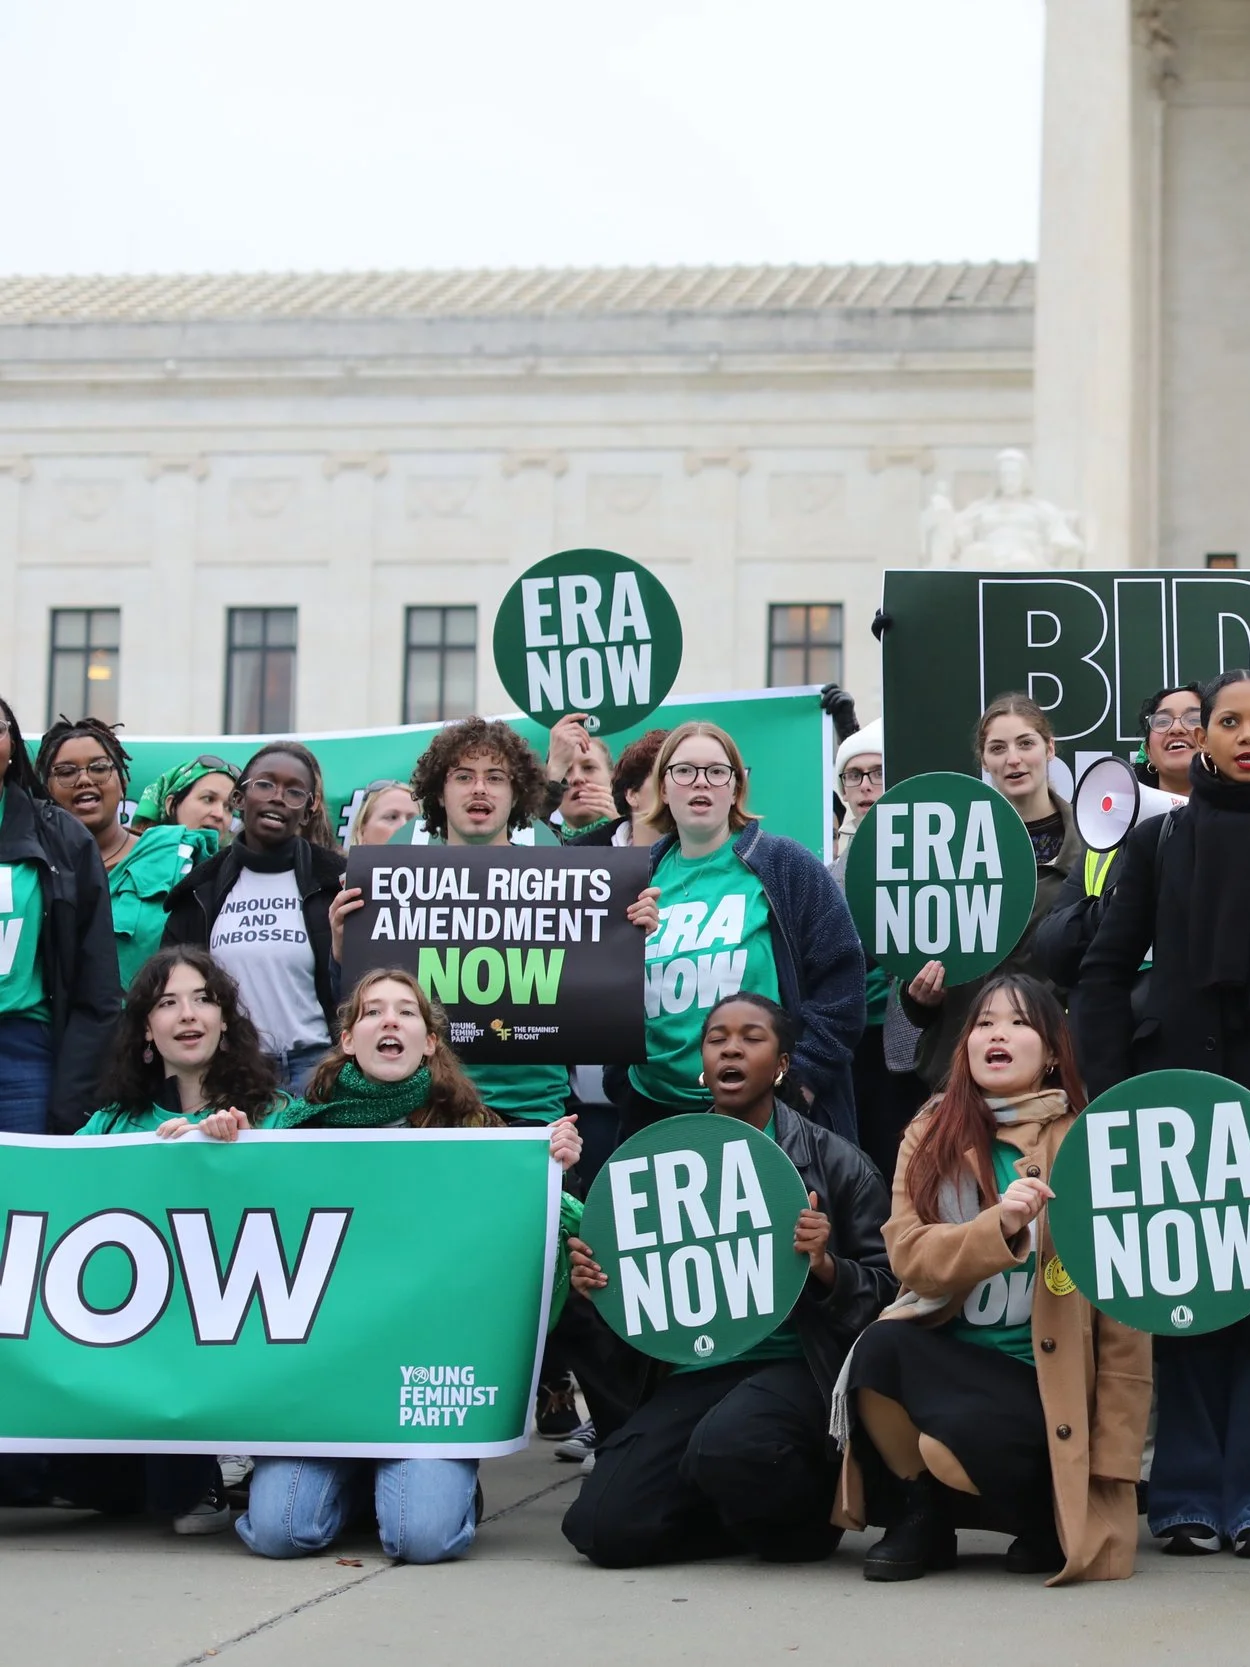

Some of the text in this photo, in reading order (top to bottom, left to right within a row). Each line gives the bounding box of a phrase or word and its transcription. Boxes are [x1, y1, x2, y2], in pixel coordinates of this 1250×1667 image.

[521, 571, 652, 648] ERA
[526, 643, 652, 713] NOW
[876, 800, 1003, 881] ERA
[371, 867, 611, 907] EQUAL RIGHTS
[220, 897, 304, 915] NBOUGHT
[238, 913, 278, 928] AND
[371, 906, 609, 943] AMENDMENT
[875, 884, 1003, 955] NOW
[211, 928, 308, 950] UNBOSSED
[417, 947, 566, 1006] NOW
[450, 1029, 485, 1037] FEMINIST
[451, 1035, 476, 1043] PARTY
[513, 1026, 559, 1034] THE FEMINIST
[514, 1033, 540, 1041] FRONT
[608, 1139, 772, 1252] ERA
[619, 1233, 774, 1337] NOW
[400, 1366, 475, 1386] YOUNG
[400, 1386, 499, 1406] FEMINIST
[400, 1406, 468, 1426] PARTY
